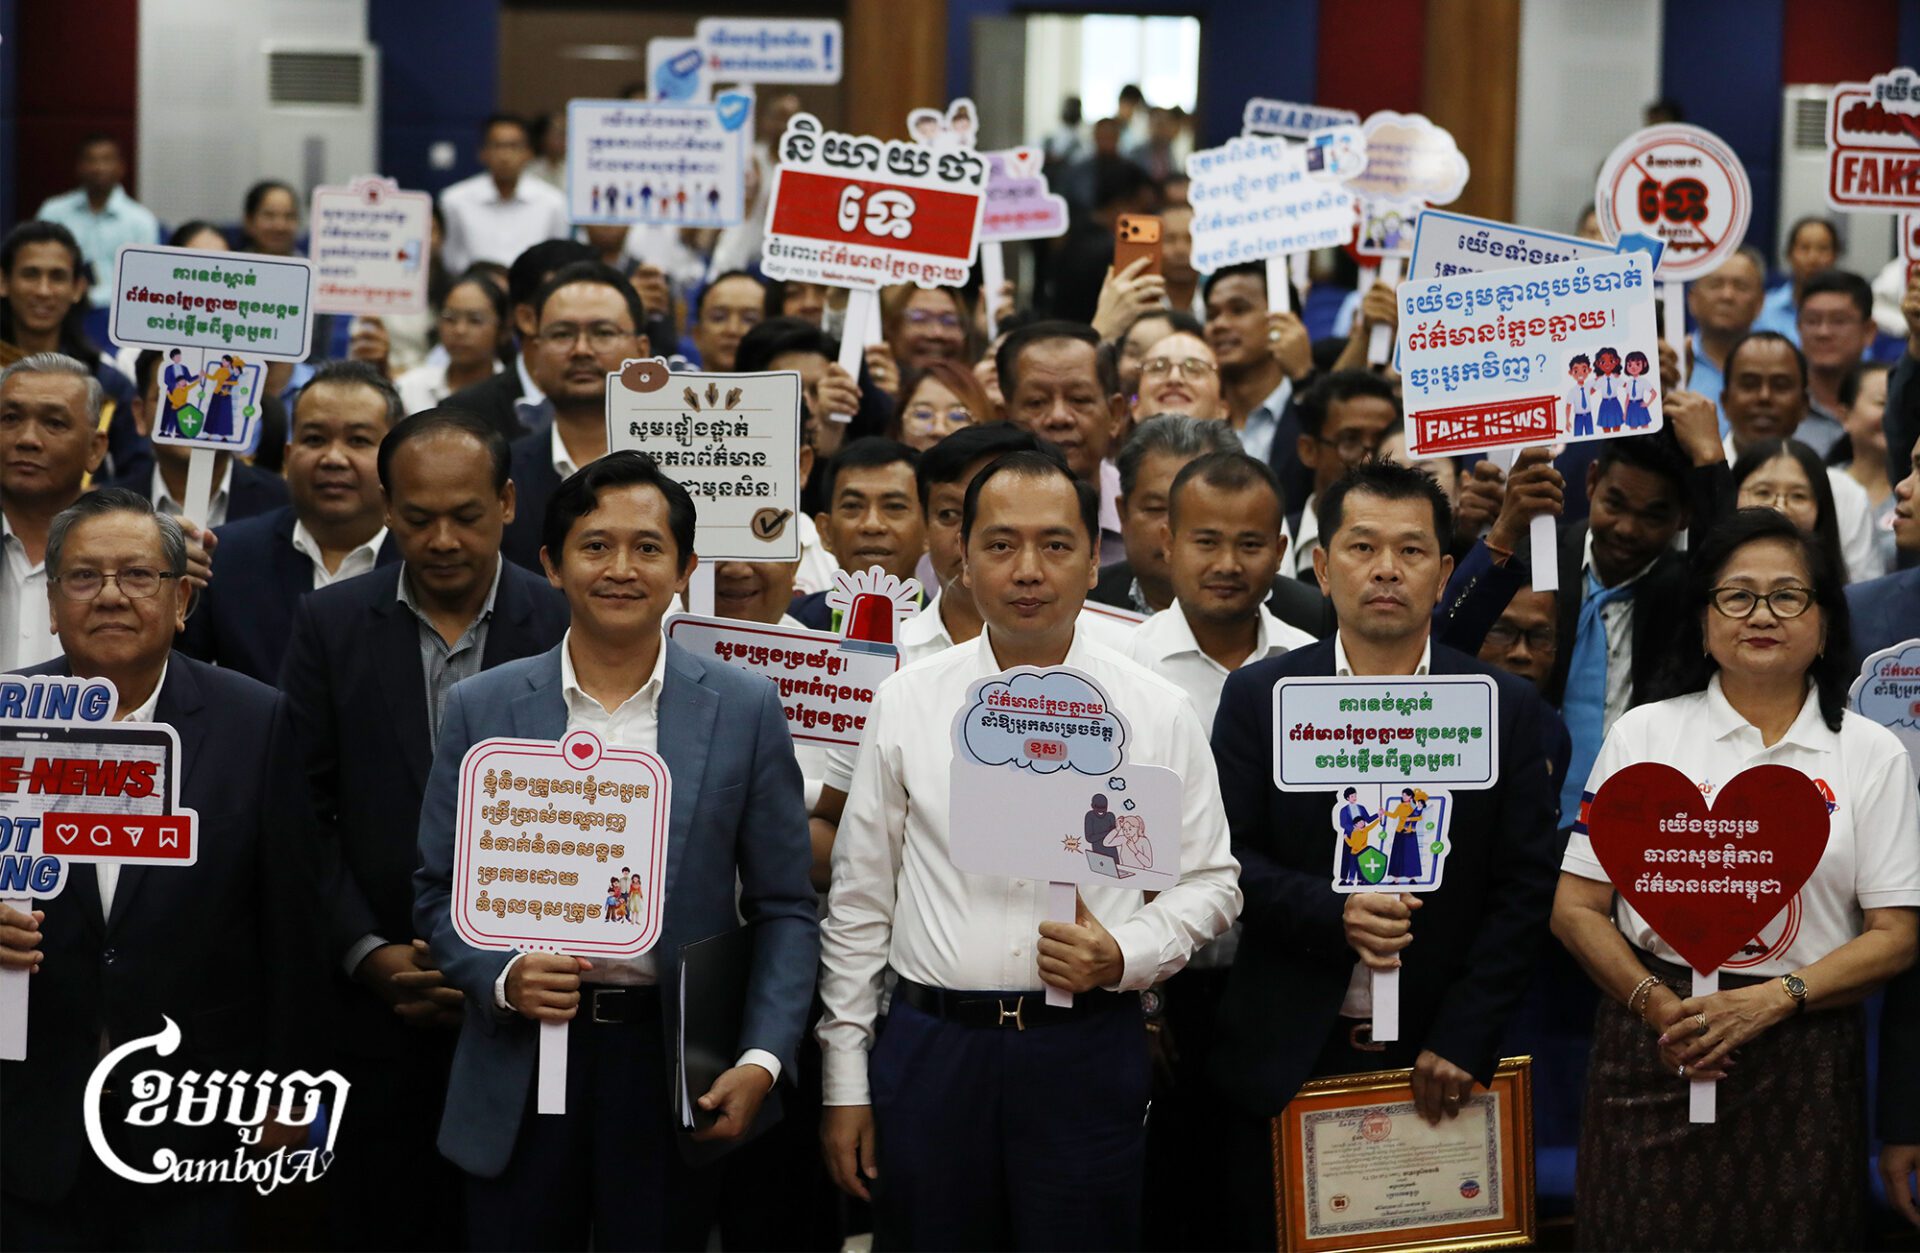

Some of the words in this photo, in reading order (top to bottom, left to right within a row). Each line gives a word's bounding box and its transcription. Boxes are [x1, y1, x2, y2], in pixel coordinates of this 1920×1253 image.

[1253, 106, 1353, 130] SHARIN
[785, 119, 985, 186] និយាយថា
[838, 185, 917, 240] ទេ
[1405, 259, 1643, 317] យើងរួមគ្នាលុបបំបាត់
[629, 413, 749, 447] សូមផ្ទៀងផ្ទាត់
[1425, 415, 1480, 443] FAKE
[1484, 407, 1547, 437] NEWS
[987, 690, 1104, 717] ព័ត៌មានក្លែងក្លាយ
[1030, 742, 1063, 757] ខុស!
[28, 758, 156, 798] NEWS
[1659, 812, 1760, 839] យើងចូលរួម
[479, 830, 625, 863] ទំនាក់ទំនងសង្គម
[1643, 843, 1774, 869] ធានាសុវត្ថិភាព
[477, 866, 579, 886] ប្រកបដោយ
[1634, 871, 1781, 903] ព័ត៌មាននៅកម្ពុជា
[476, 890, 602, 923] ទំនួលខុសត្រូវ
